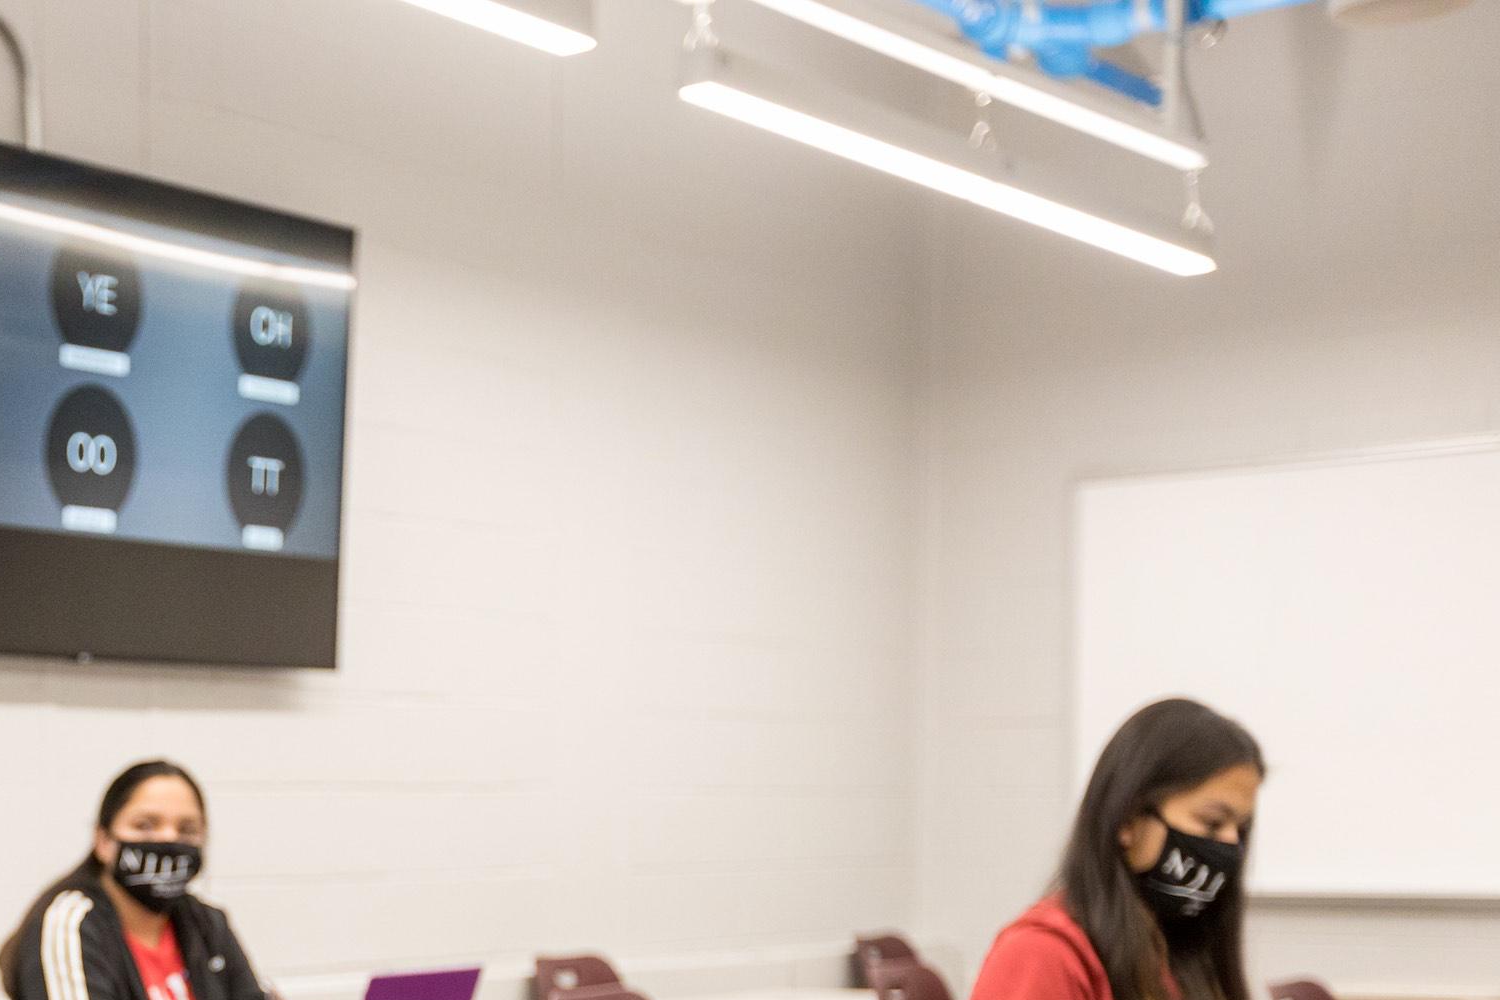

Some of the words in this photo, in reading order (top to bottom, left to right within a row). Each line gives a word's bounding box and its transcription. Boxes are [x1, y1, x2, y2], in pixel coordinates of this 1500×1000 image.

[76, 271, 118, 315] YE
[246, 456, 285, 497] TT
[1161, 848, 1226, 900] NJI
